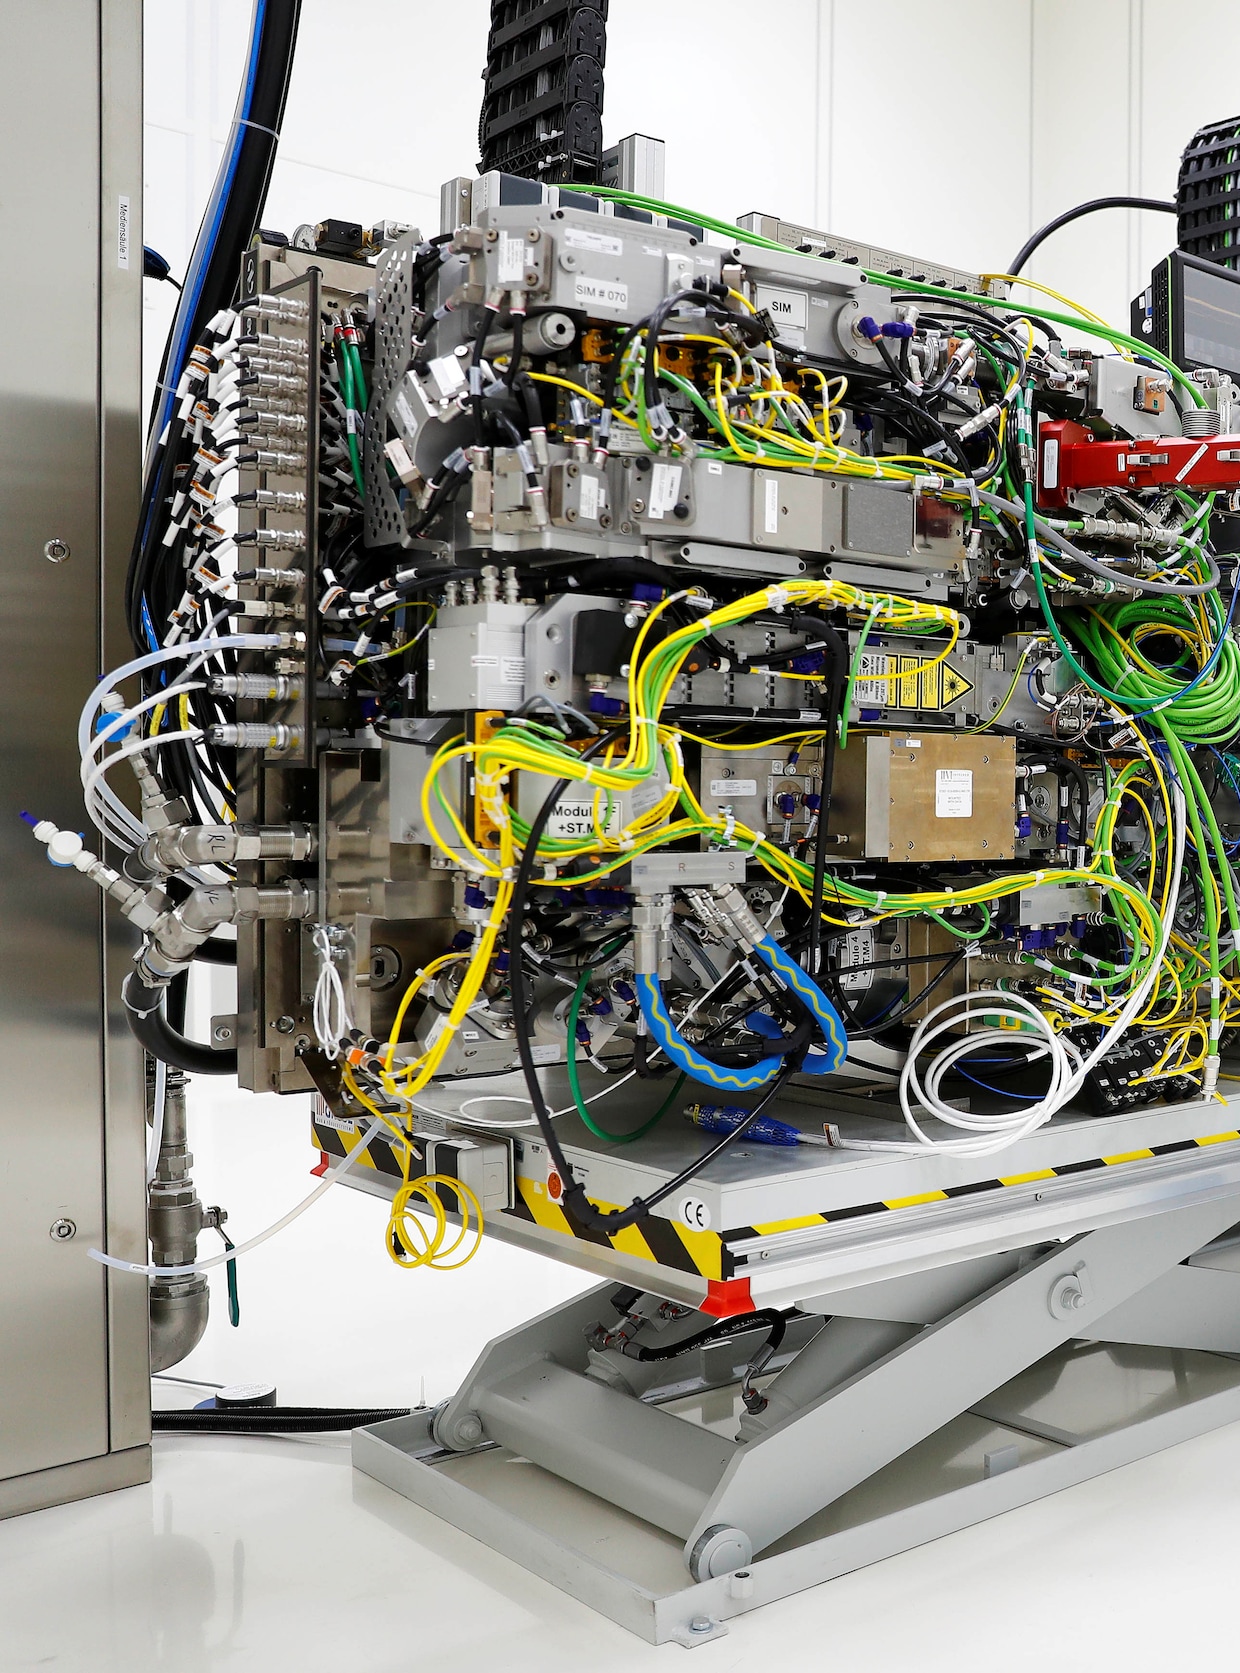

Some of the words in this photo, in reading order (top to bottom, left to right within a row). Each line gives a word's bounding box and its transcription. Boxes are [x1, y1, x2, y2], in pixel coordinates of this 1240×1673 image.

[576, 284, 596, 296] SIM
[608, 290, 626, 302] 070
[772, 301, 792, 314] SIM
[552, 806, 592, 816] Modul
[208, 834, 226, 855] RL
[678, 862, 686, 872] R
[728, 862, 736, 871] S
[850, 945, 860, 982] Mdule
[862, 940, 870, 977] +T.M4
[684, 1201, 704, 1228] CE
